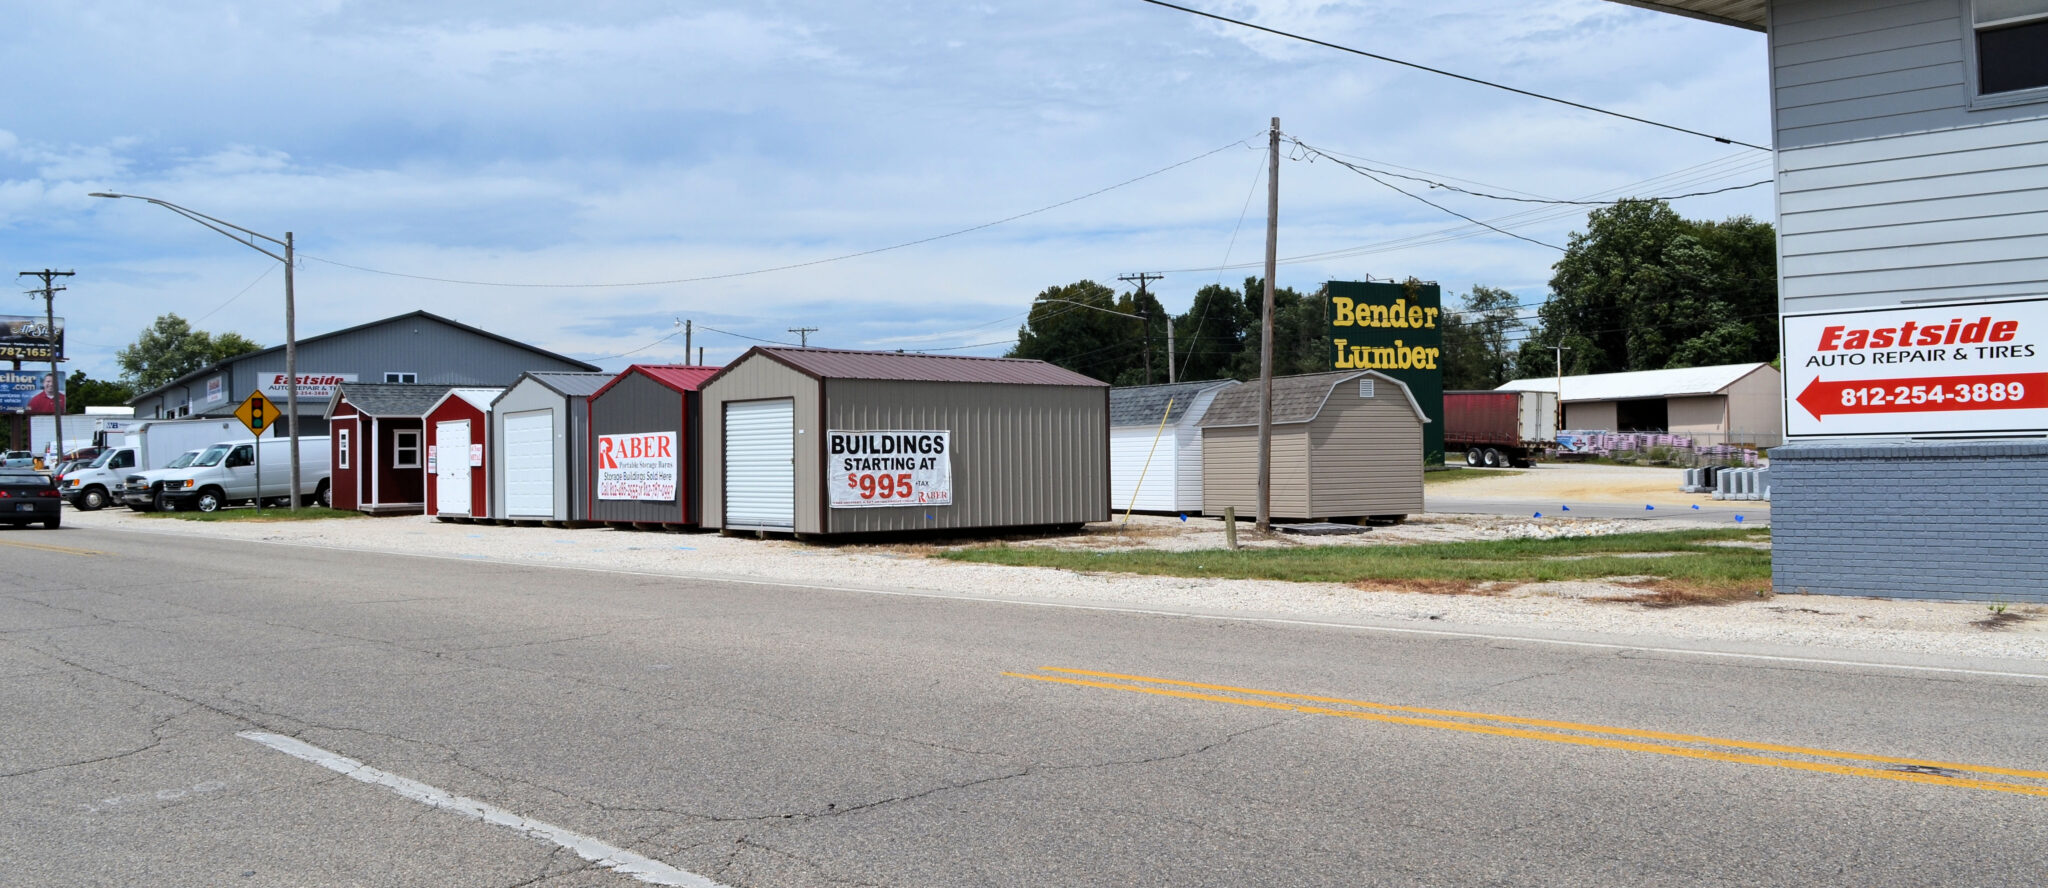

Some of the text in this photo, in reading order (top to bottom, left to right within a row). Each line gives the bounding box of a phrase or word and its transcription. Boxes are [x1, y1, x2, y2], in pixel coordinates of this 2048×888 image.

[1332, 296, 1438, 328] Bender
[1817, 316, 2019, 351] Eastside
[1333, 339, 1439, 369] Lumber
[1805, 344, 2035, 367] AUTO REPAIR & TIRES
[1841, 382, 2025, 407] 812-254-3889
[599, 436, 672, 469] RABER
[831, 435, 945, 455] BUILDINGS
[844, 457, 936, 471] STARTING AT
[604, 471, 672, 483] Storage Buildings Sold Here
[848, 473, 913, 499] $995
[918, 491, 948, 503] RABER
